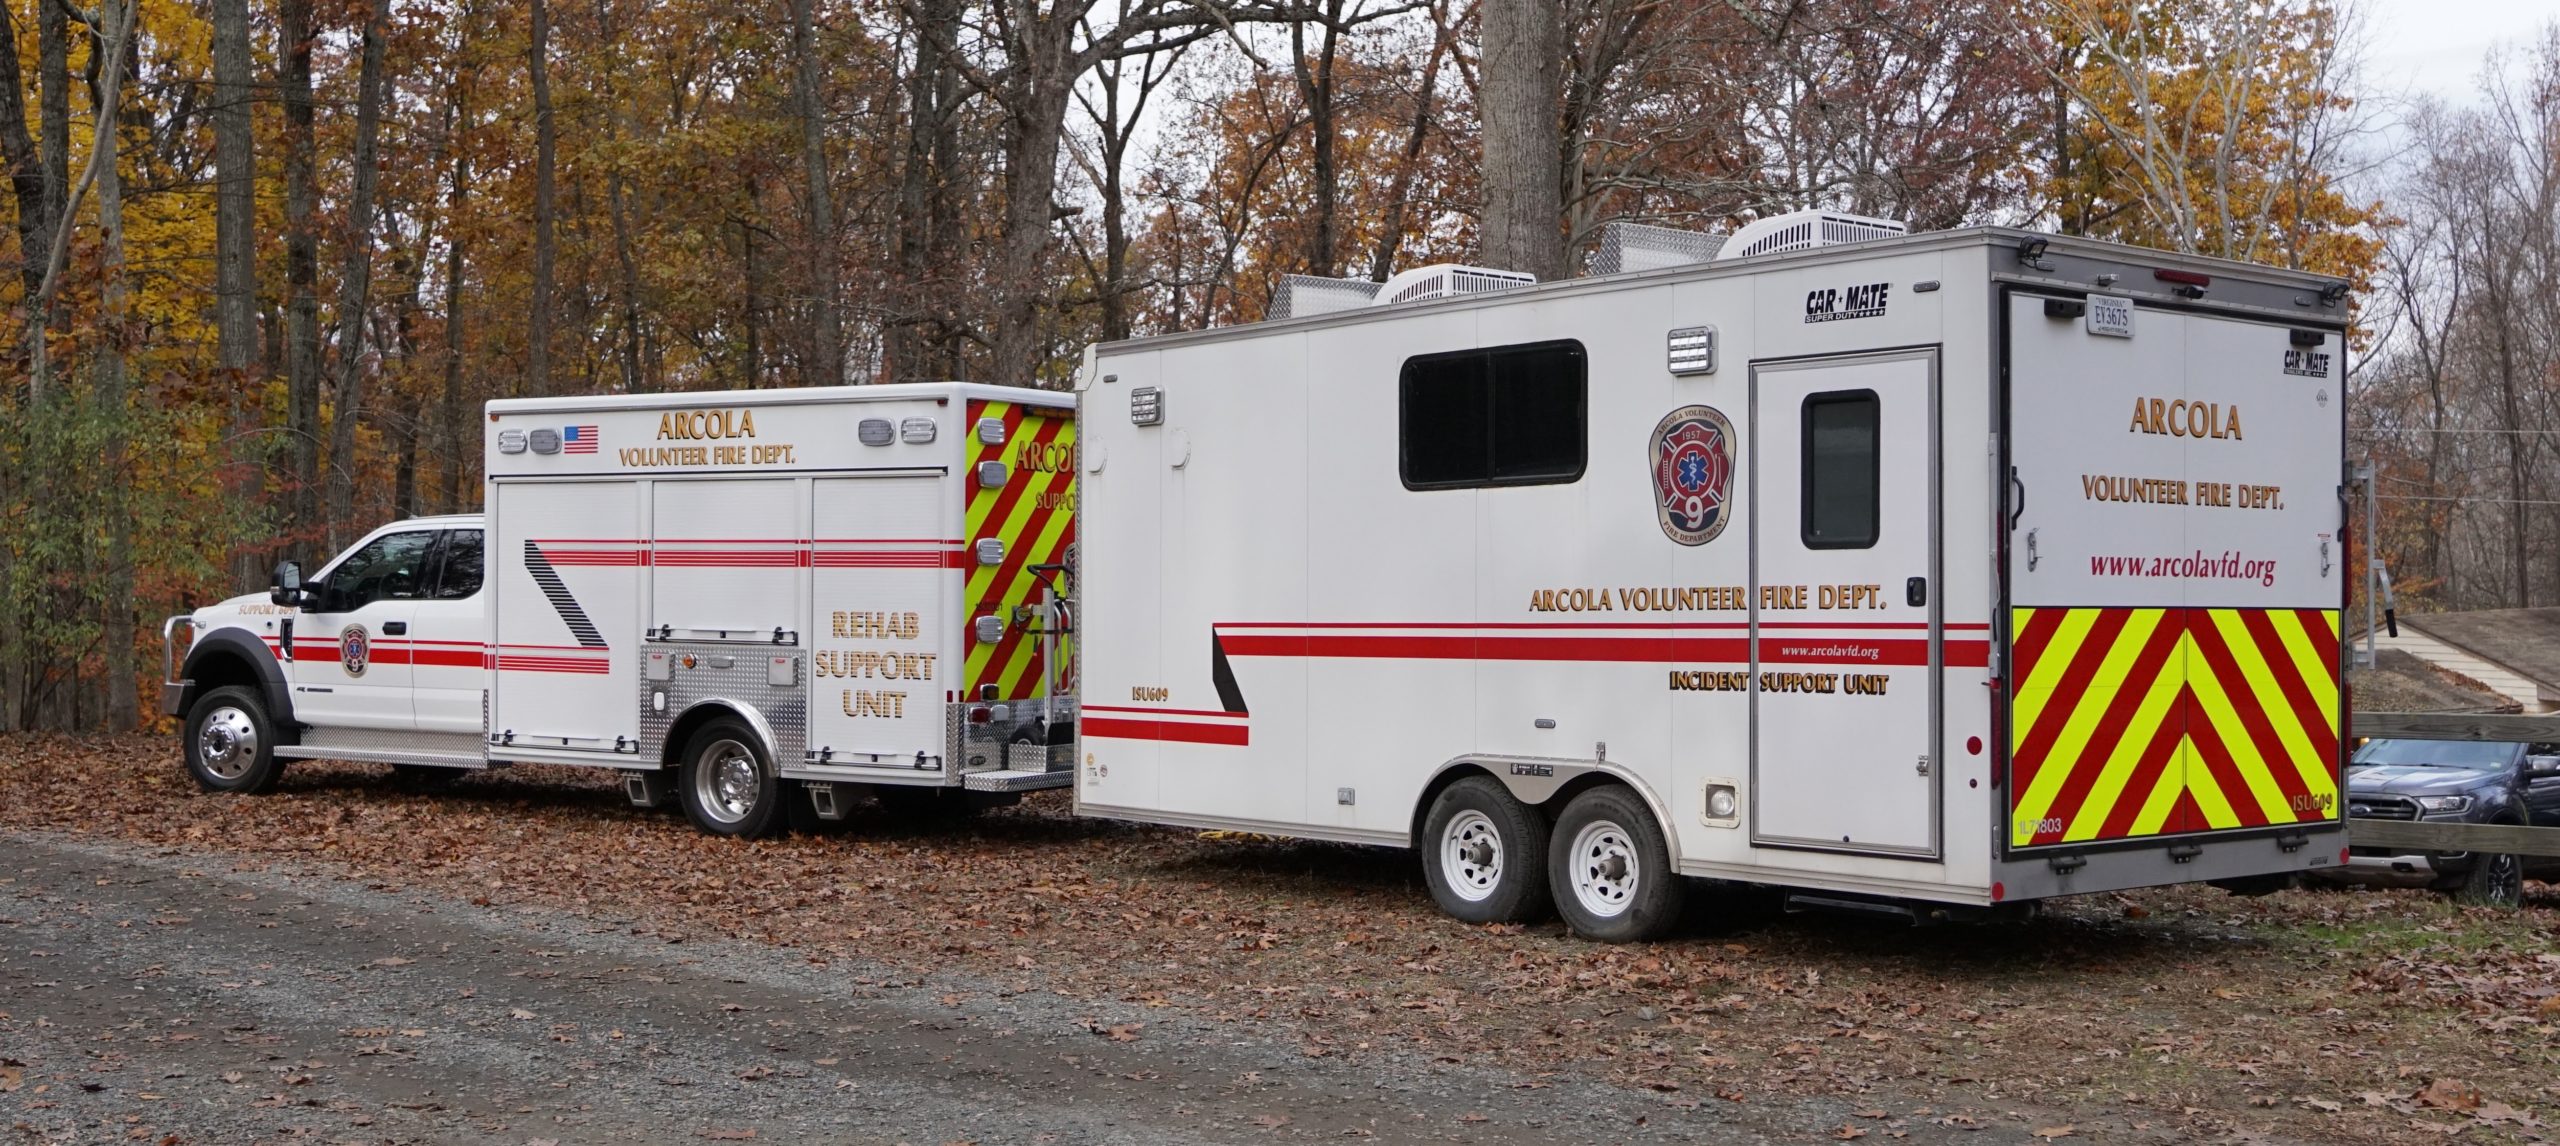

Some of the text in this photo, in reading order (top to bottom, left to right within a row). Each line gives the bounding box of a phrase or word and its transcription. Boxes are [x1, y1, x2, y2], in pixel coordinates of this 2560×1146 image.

[1807, 283, 1888, 314] CAR MATE
[1805, 311, 1858, 323] SUPER DUTY
[2284, 350, 2328, 371] CAR MATE
[657, 410, 756, 440] ARCOLA
[1658, 409, 1726, 436] ARCOLA VOLUNTEER
[2129, 397, 2242, 440] ARCOLA
[1682, 431, 1701, 441] 1957
[619, 444, 796, 467] VOLUNTEER FIRE DEPT.
[1014, 440, 1077, 473] ARCO
[1036, 492, 1076, 511] SUPPO
[2082, 474, 2285, 510] VOLUNTEER FIRE DEPT.
[1685, 495, 1704, 529] 9
[1663, 515, 1725, 542] FIRE DEPARTMENT
[2091, 550, 2276, 587] www.arcolavfd.org
[1529, 584, 1887, 612] ARCOLA VOLUNTEER FIRE DEPT.
[832, 611, 920, 640] REHAB
[351, 659, 359, 671] 9
[815, 650, 937, 680] SUPPORT
[1782, 644, 1880, 660] www.arcolavfd.org
[1132, 686, 1169, 702] ISU609
[1669, 670, 1889, 695] INCIDENT SUPPORT UNIT
[843, 689, 907, 719] UNIT
[2293, 793, 2333, 811] ISU609
